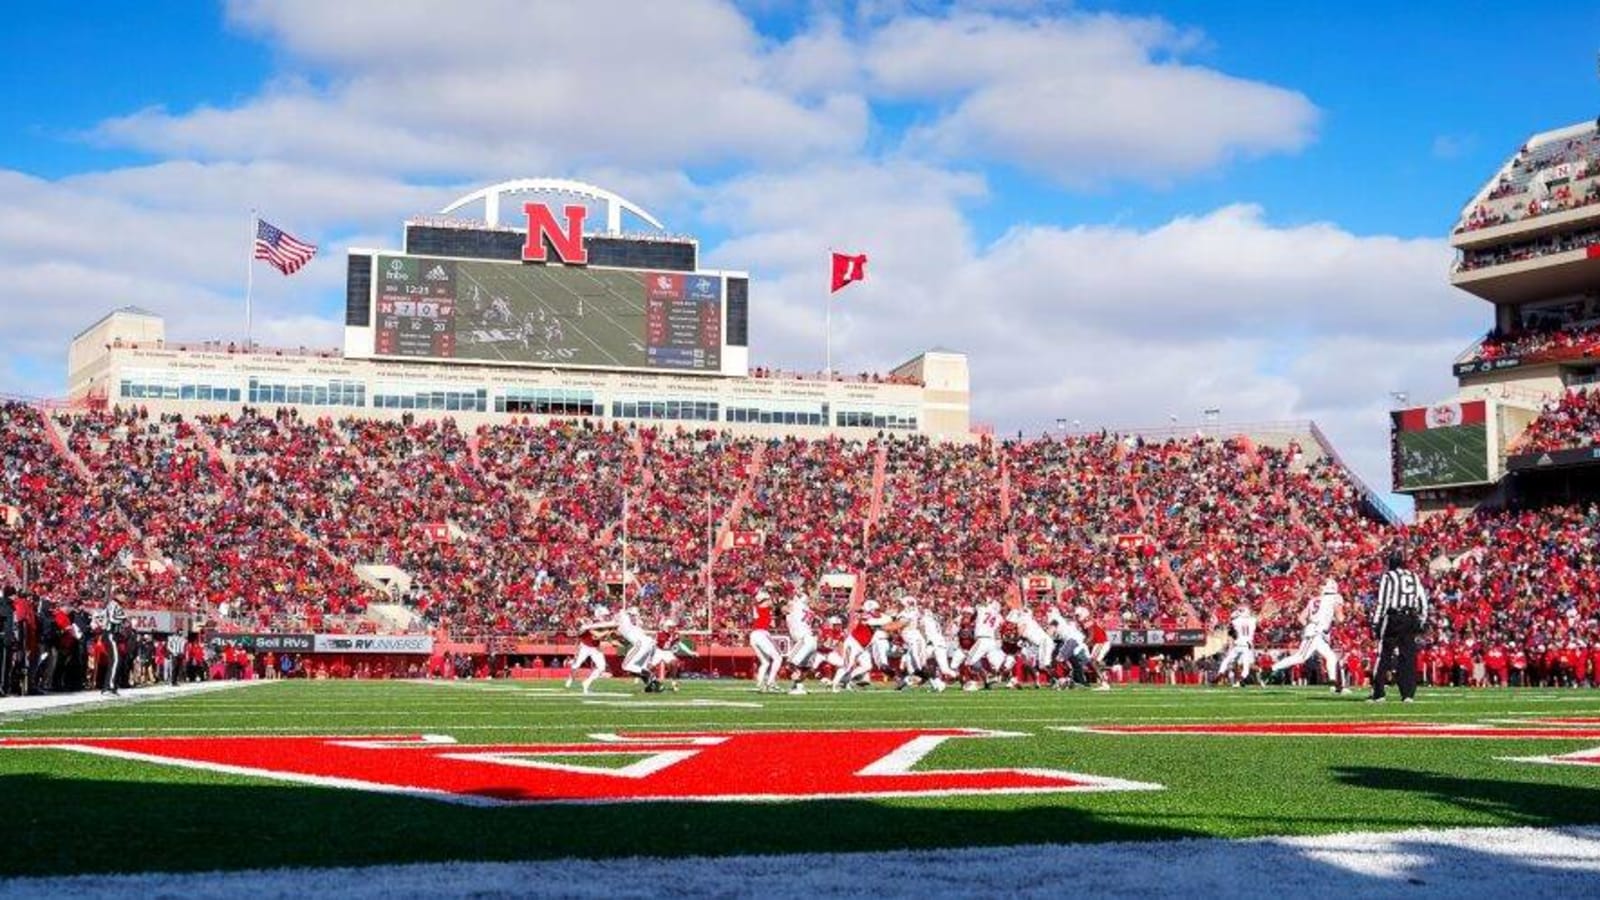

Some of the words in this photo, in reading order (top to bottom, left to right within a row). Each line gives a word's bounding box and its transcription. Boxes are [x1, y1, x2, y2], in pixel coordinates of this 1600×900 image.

[522, 201, 588, 264] N
[422, 305, 431, 316] 0
[256, 637, 279, 647] Sell
[283, 638, 309, 648] RVs
